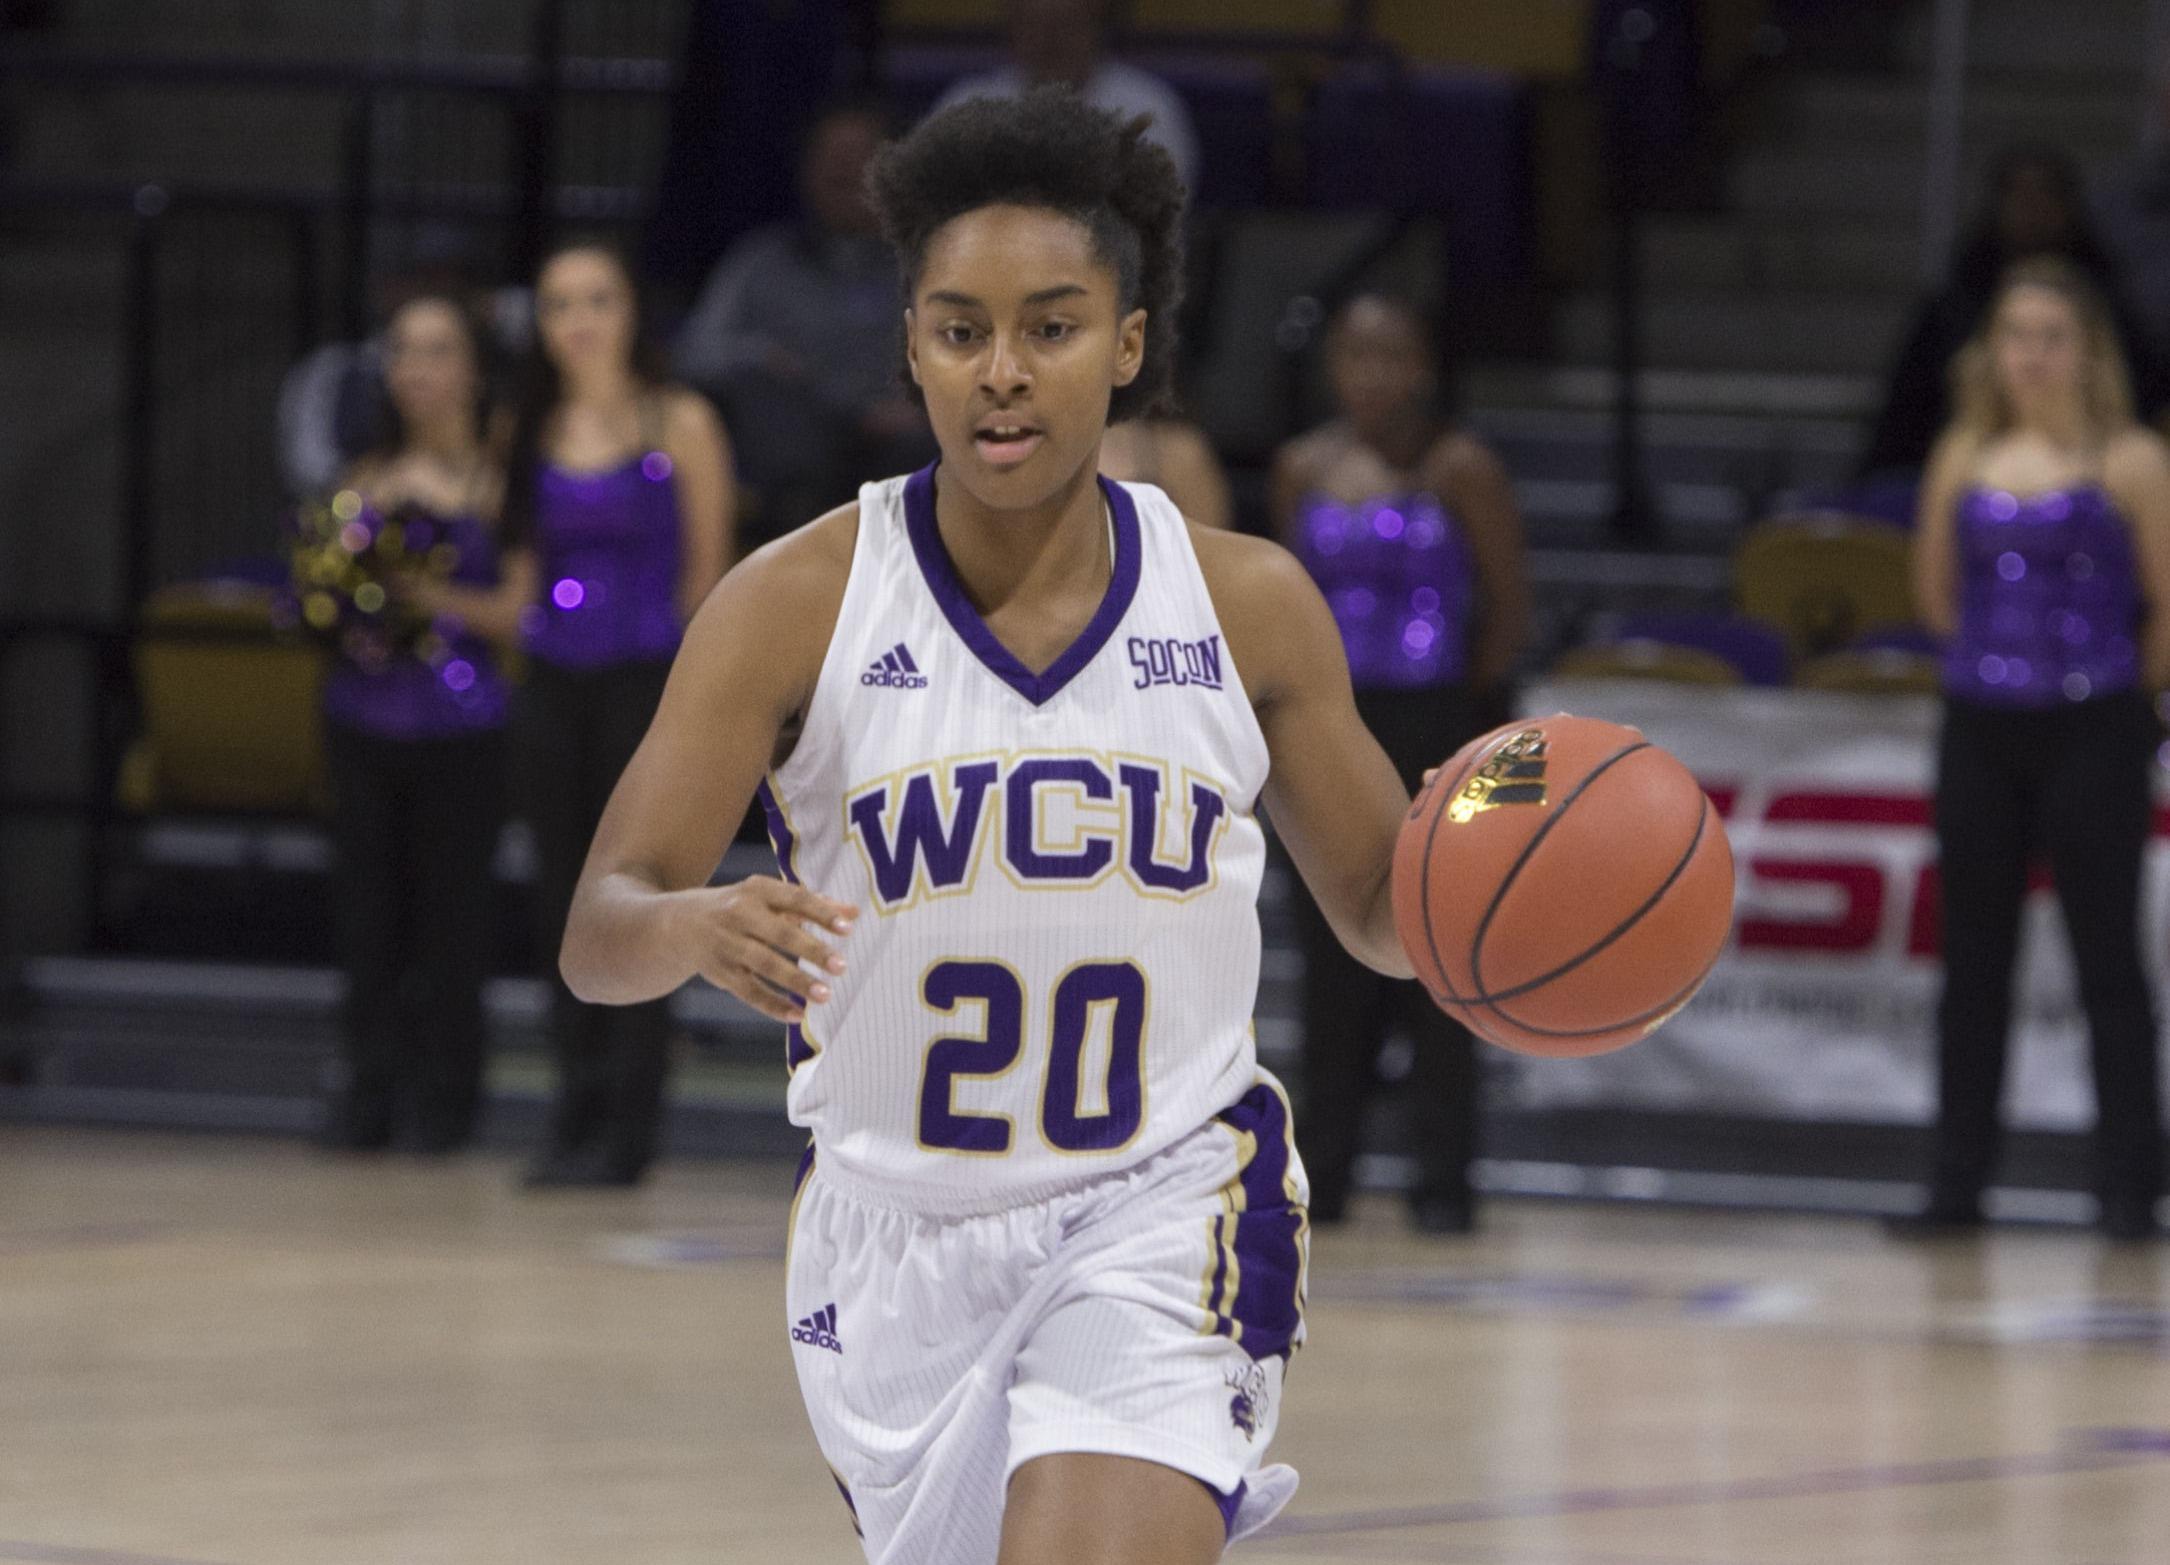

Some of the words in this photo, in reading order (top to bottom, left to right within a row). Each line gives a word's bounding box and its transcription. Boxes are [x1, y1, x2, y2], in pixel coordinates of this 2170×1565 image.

[861, 670, 928, 689] adidas
[1127, 635, 1223, 690] SOCON
[845, 748, 1231, 916] WCU
[916, 955, 1152, 1157] 20
[791, 1327, 843, 1355] adidas
